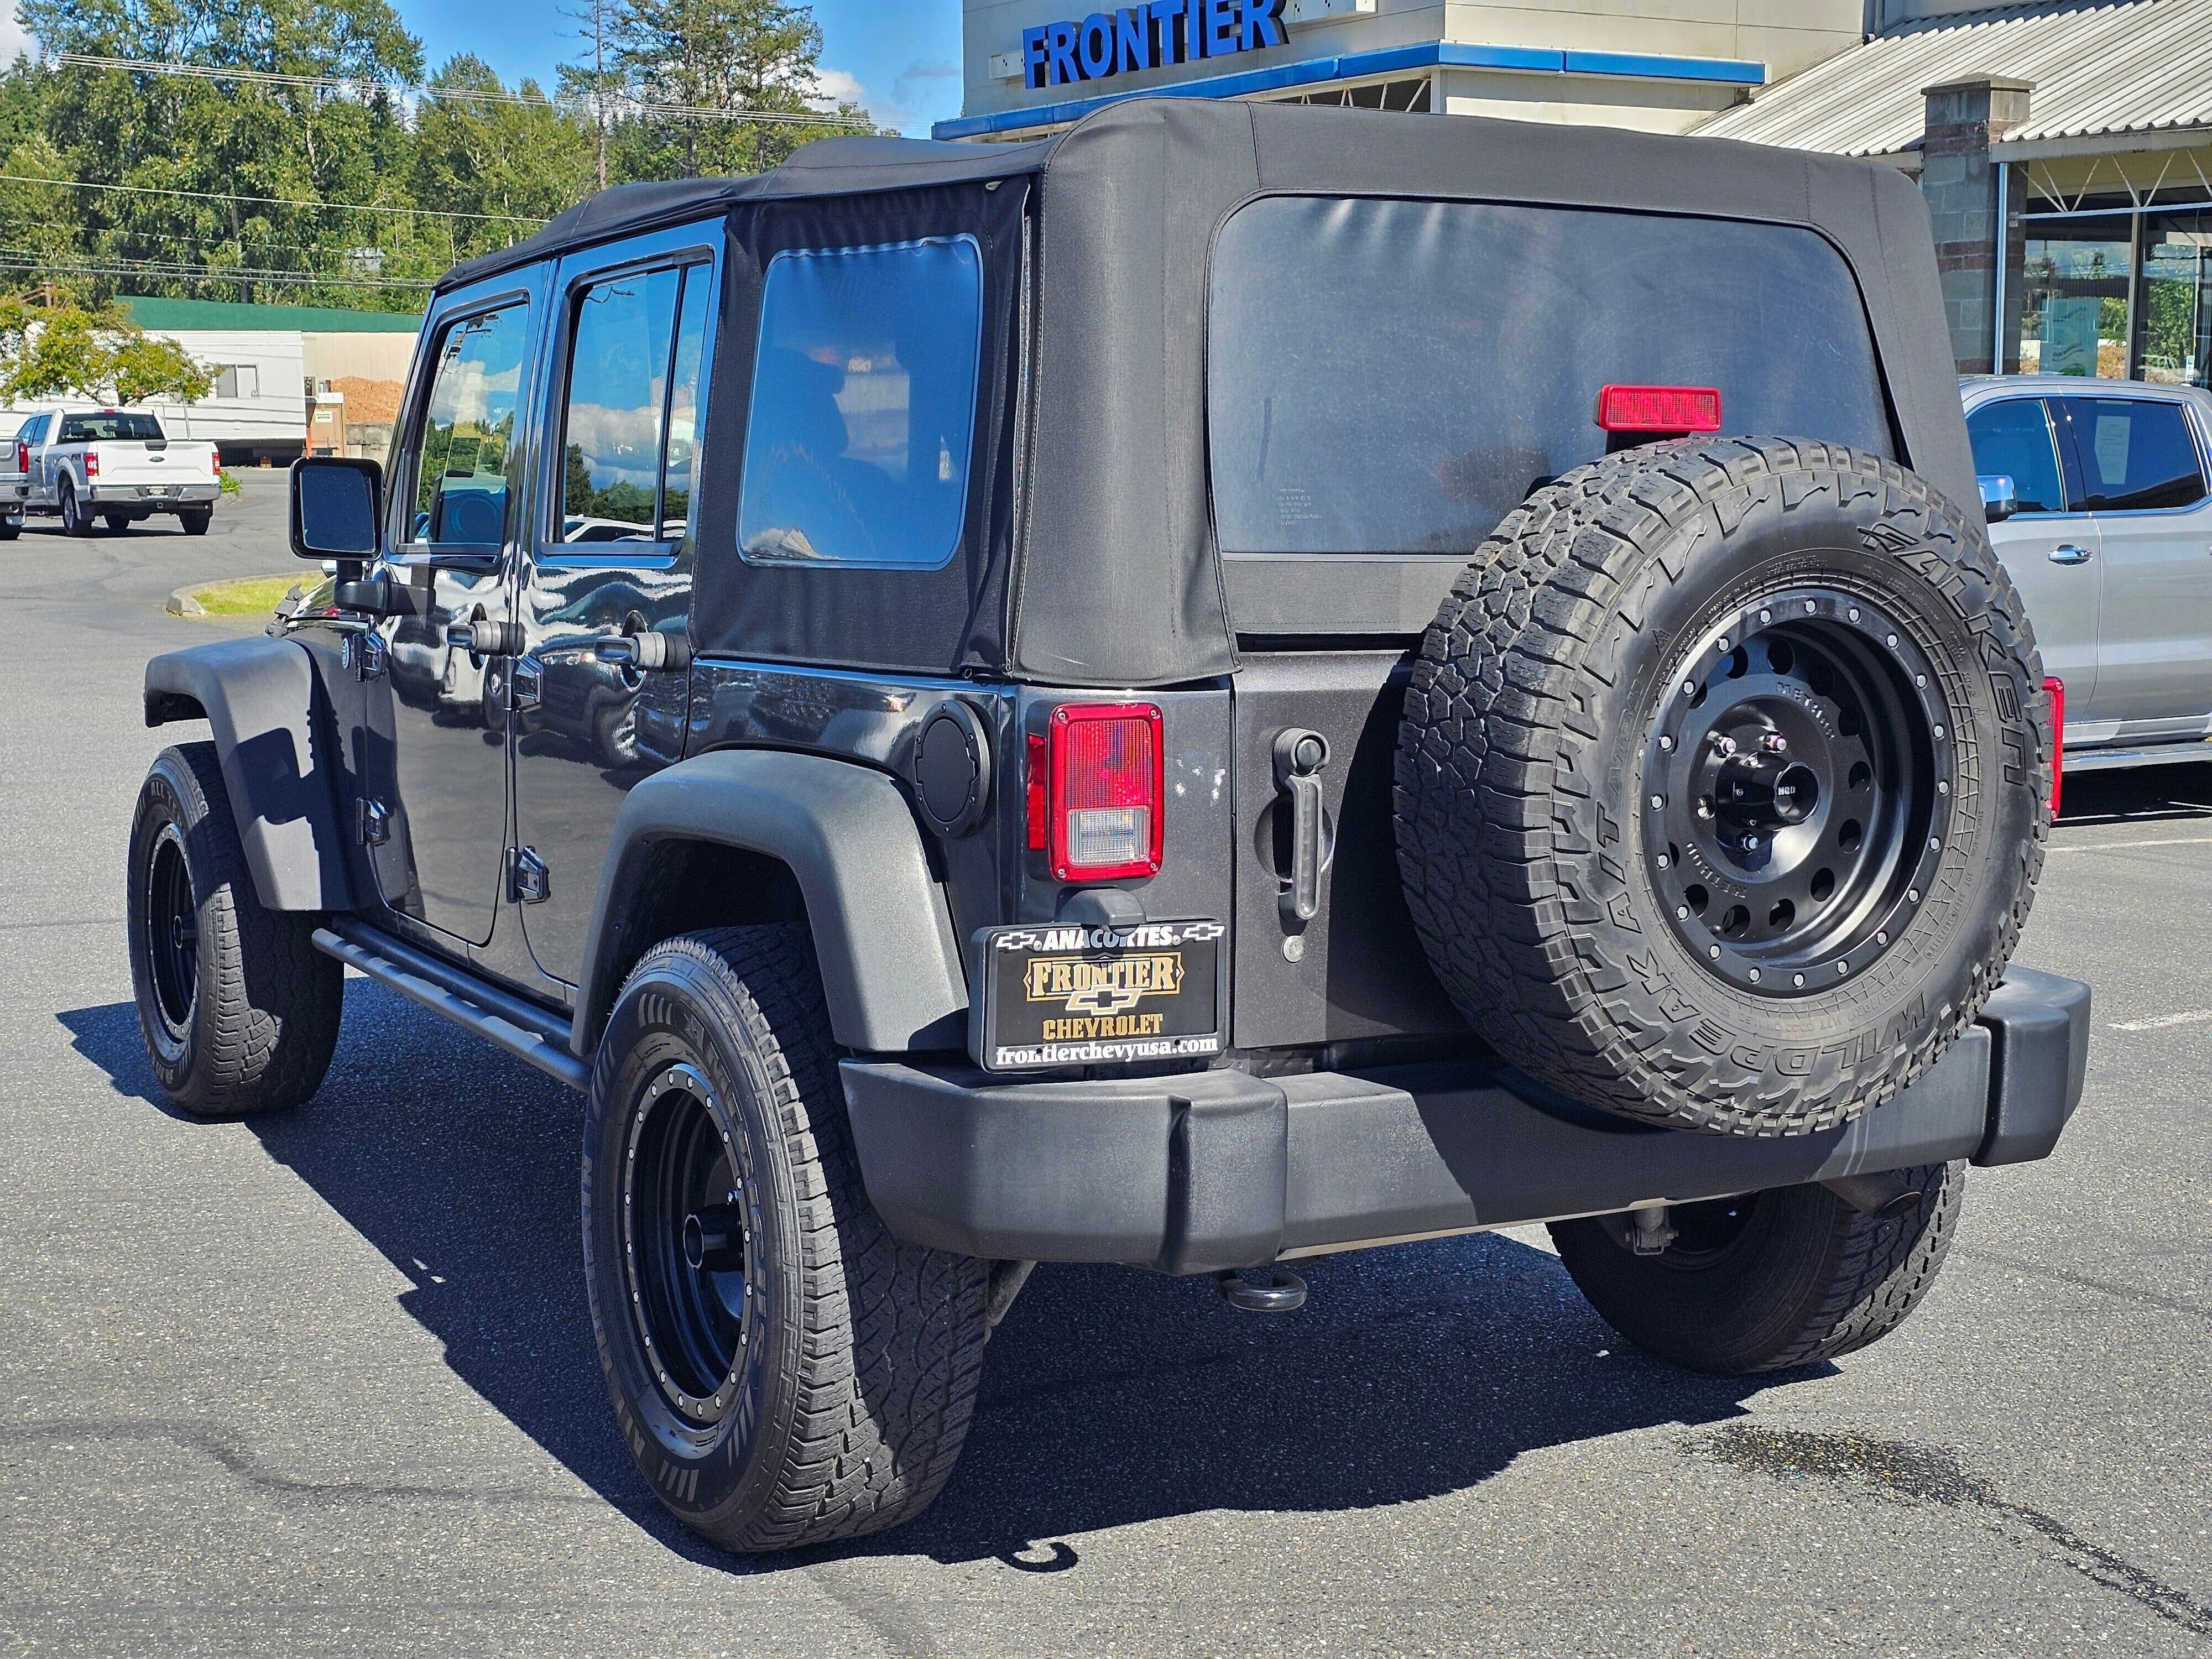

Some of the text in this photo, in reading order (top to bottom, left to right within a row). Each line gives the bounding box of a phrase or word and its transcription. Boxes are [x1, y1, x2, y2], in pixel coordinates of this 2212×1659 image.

[1023, 0, 1283, 89] FRONTIER
[1856, 522, 2027, 786] FALKEN
[1777, 681, 1835, 740] METHOD
[1042, 926, 1173, 951] ANACORTES
[1031, 957, 1176, 997] FRONTIER
[1626, 947, 1927, 1077] WILDPEAK
[996, 1037, 1218, 1065] frontierchevyusa.com
[1042, 1013, 1164, 1041] CHEVROLET
[684, 1013, 766, 1366] AMERICUS
[581, 1153, 646, 1459] ALL TERRAIN
